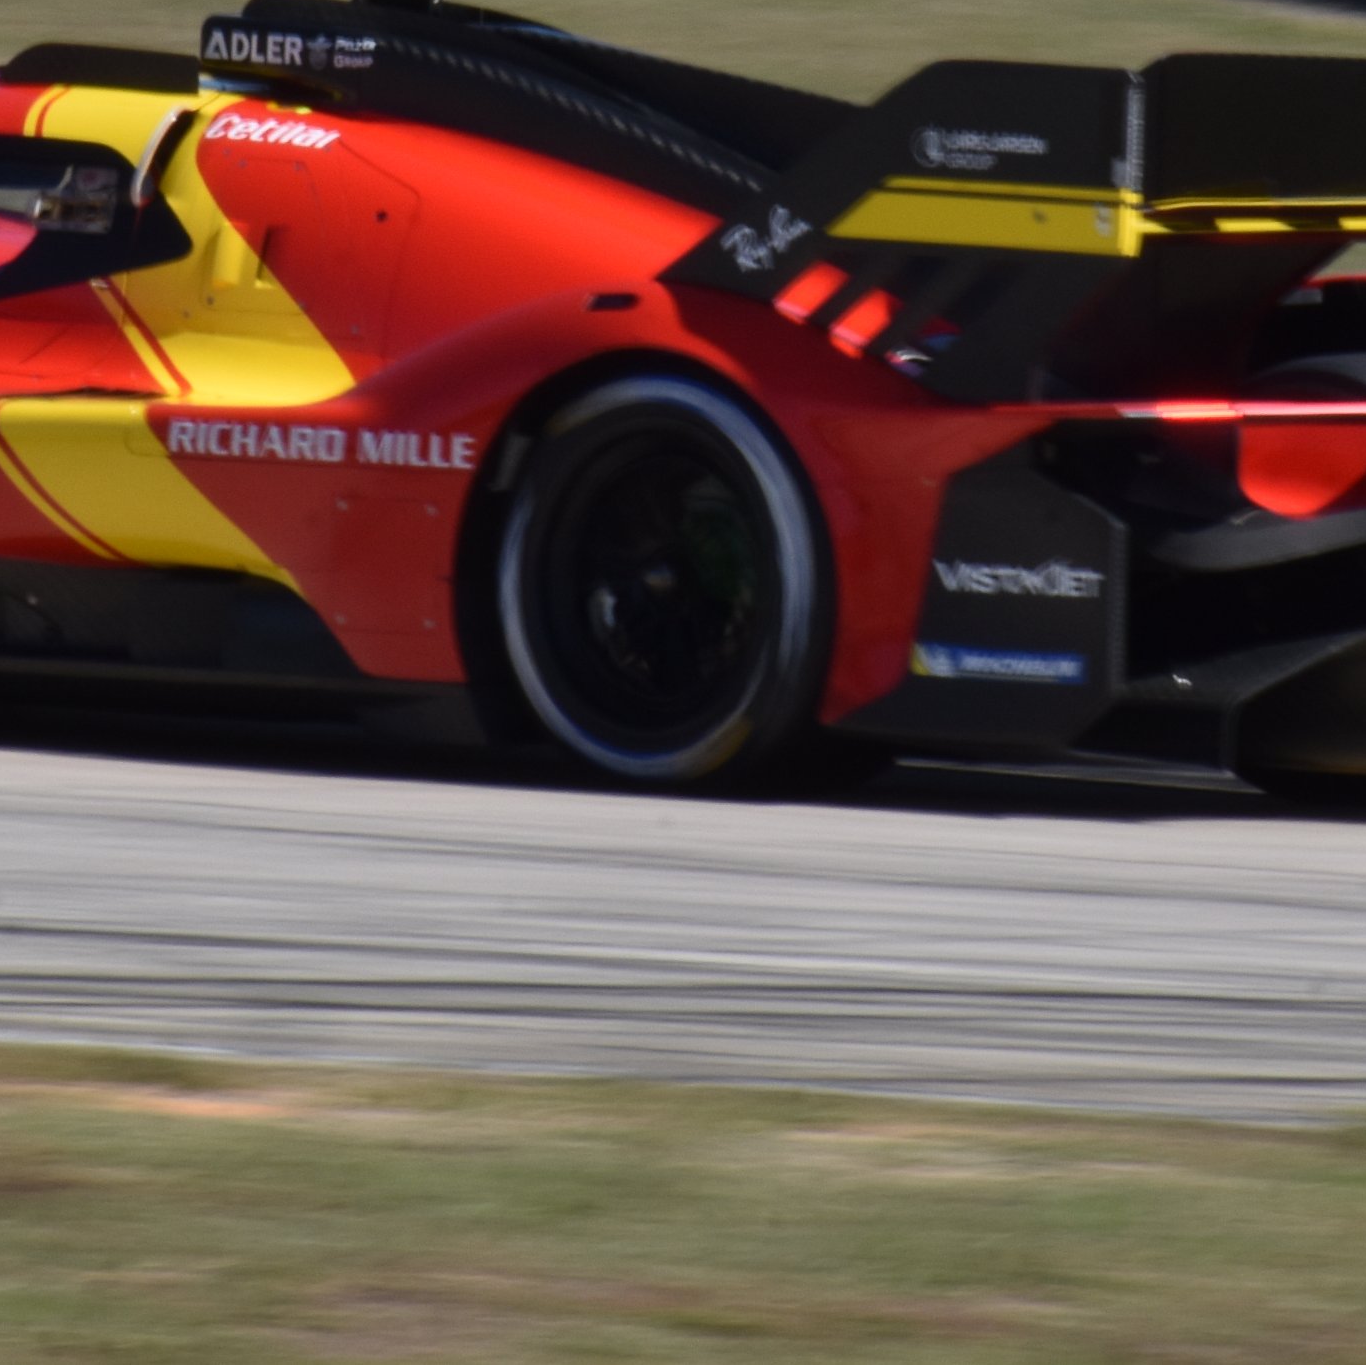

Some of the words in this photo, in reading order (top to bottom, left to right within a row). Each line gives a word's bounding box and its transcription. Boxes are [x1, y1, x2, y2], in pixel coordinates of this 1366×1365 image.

[204, 29, 303, 66] ADLER
[205, 112, 340, 149] Cetilar
[168, 418, 347, 462] RICHARD
[356, 428, 477, 470] MILLE
